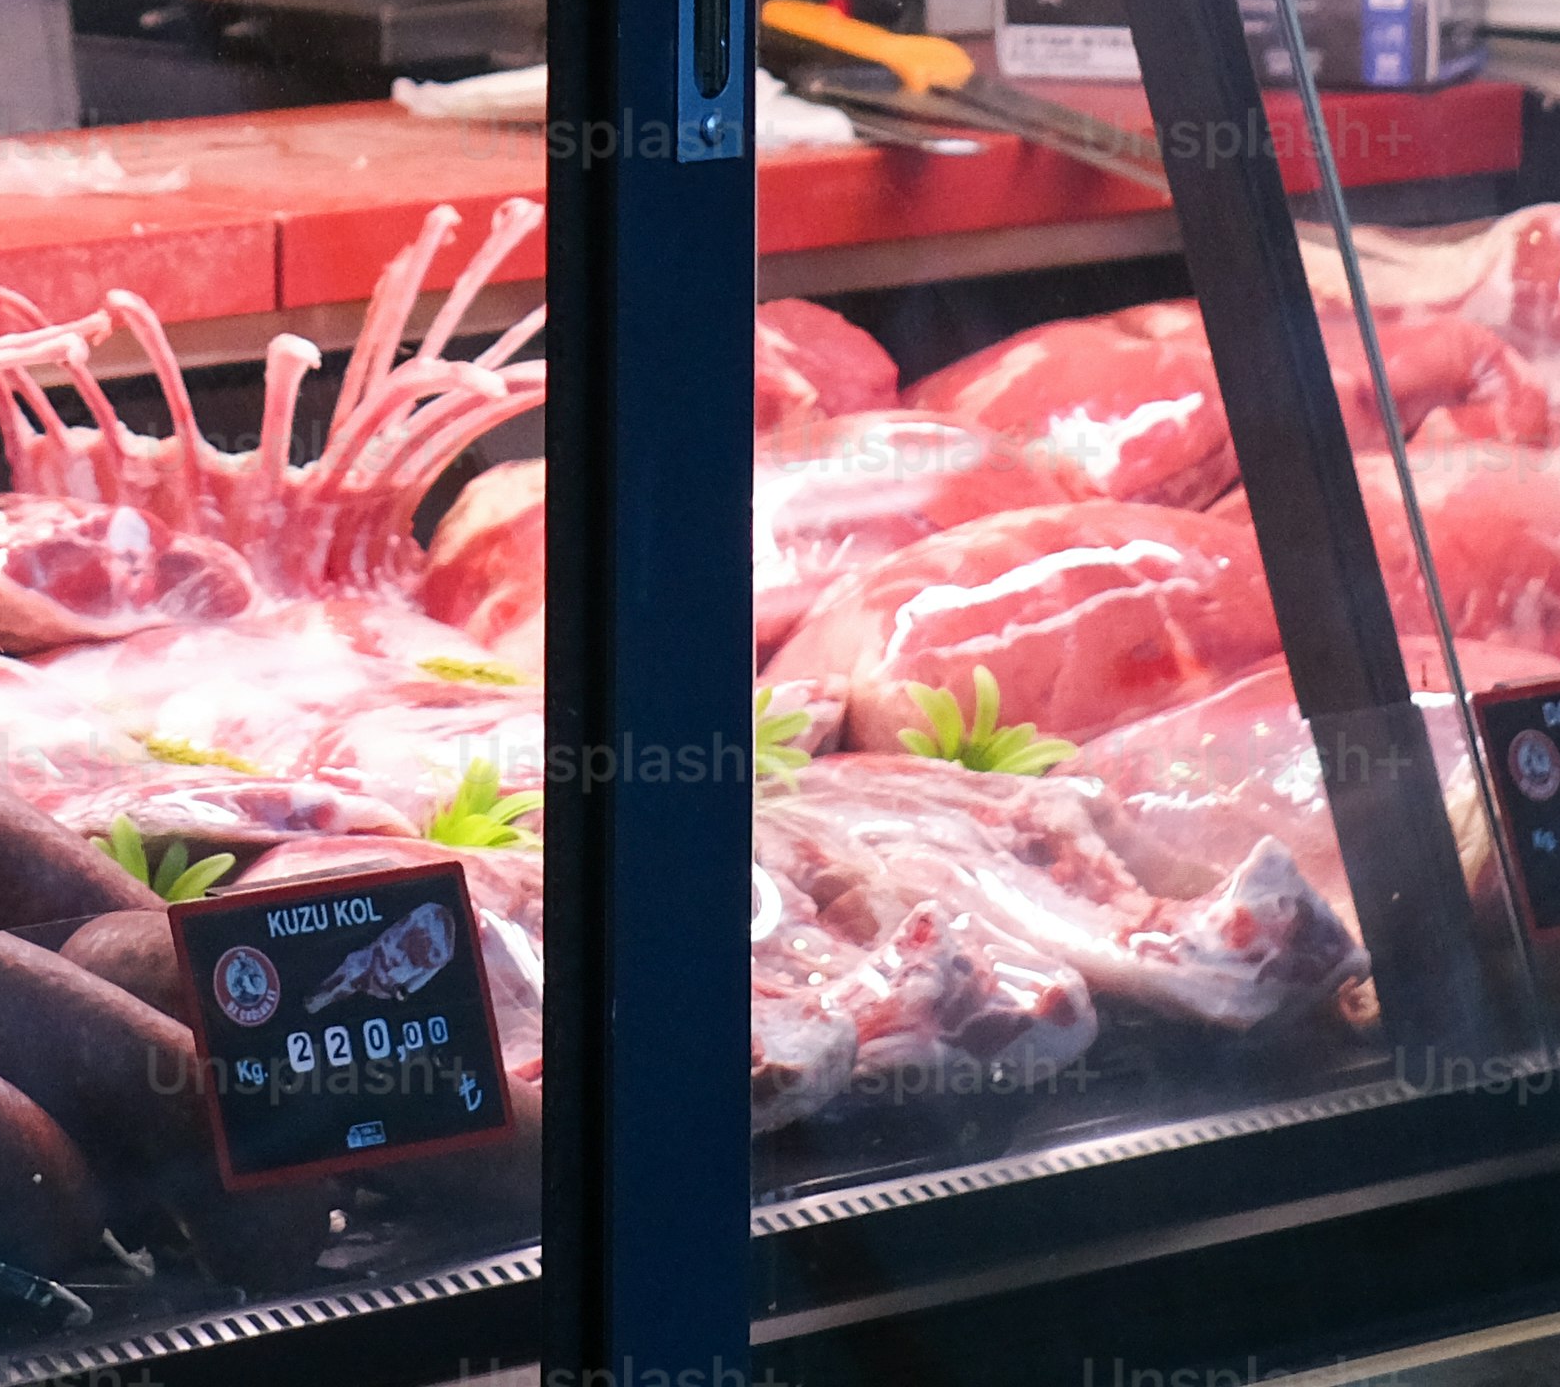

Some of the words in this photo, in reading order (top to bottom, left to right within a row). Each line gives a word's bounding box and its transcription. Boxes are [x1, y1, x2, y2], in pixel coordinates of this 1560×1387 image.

[266, 903, 329, 938] KUZU
[332, 896, 383, 927] KOL
[236, 1059, 269, 1086] Kg.
[288, 1017, 448, 1071] 220,00
